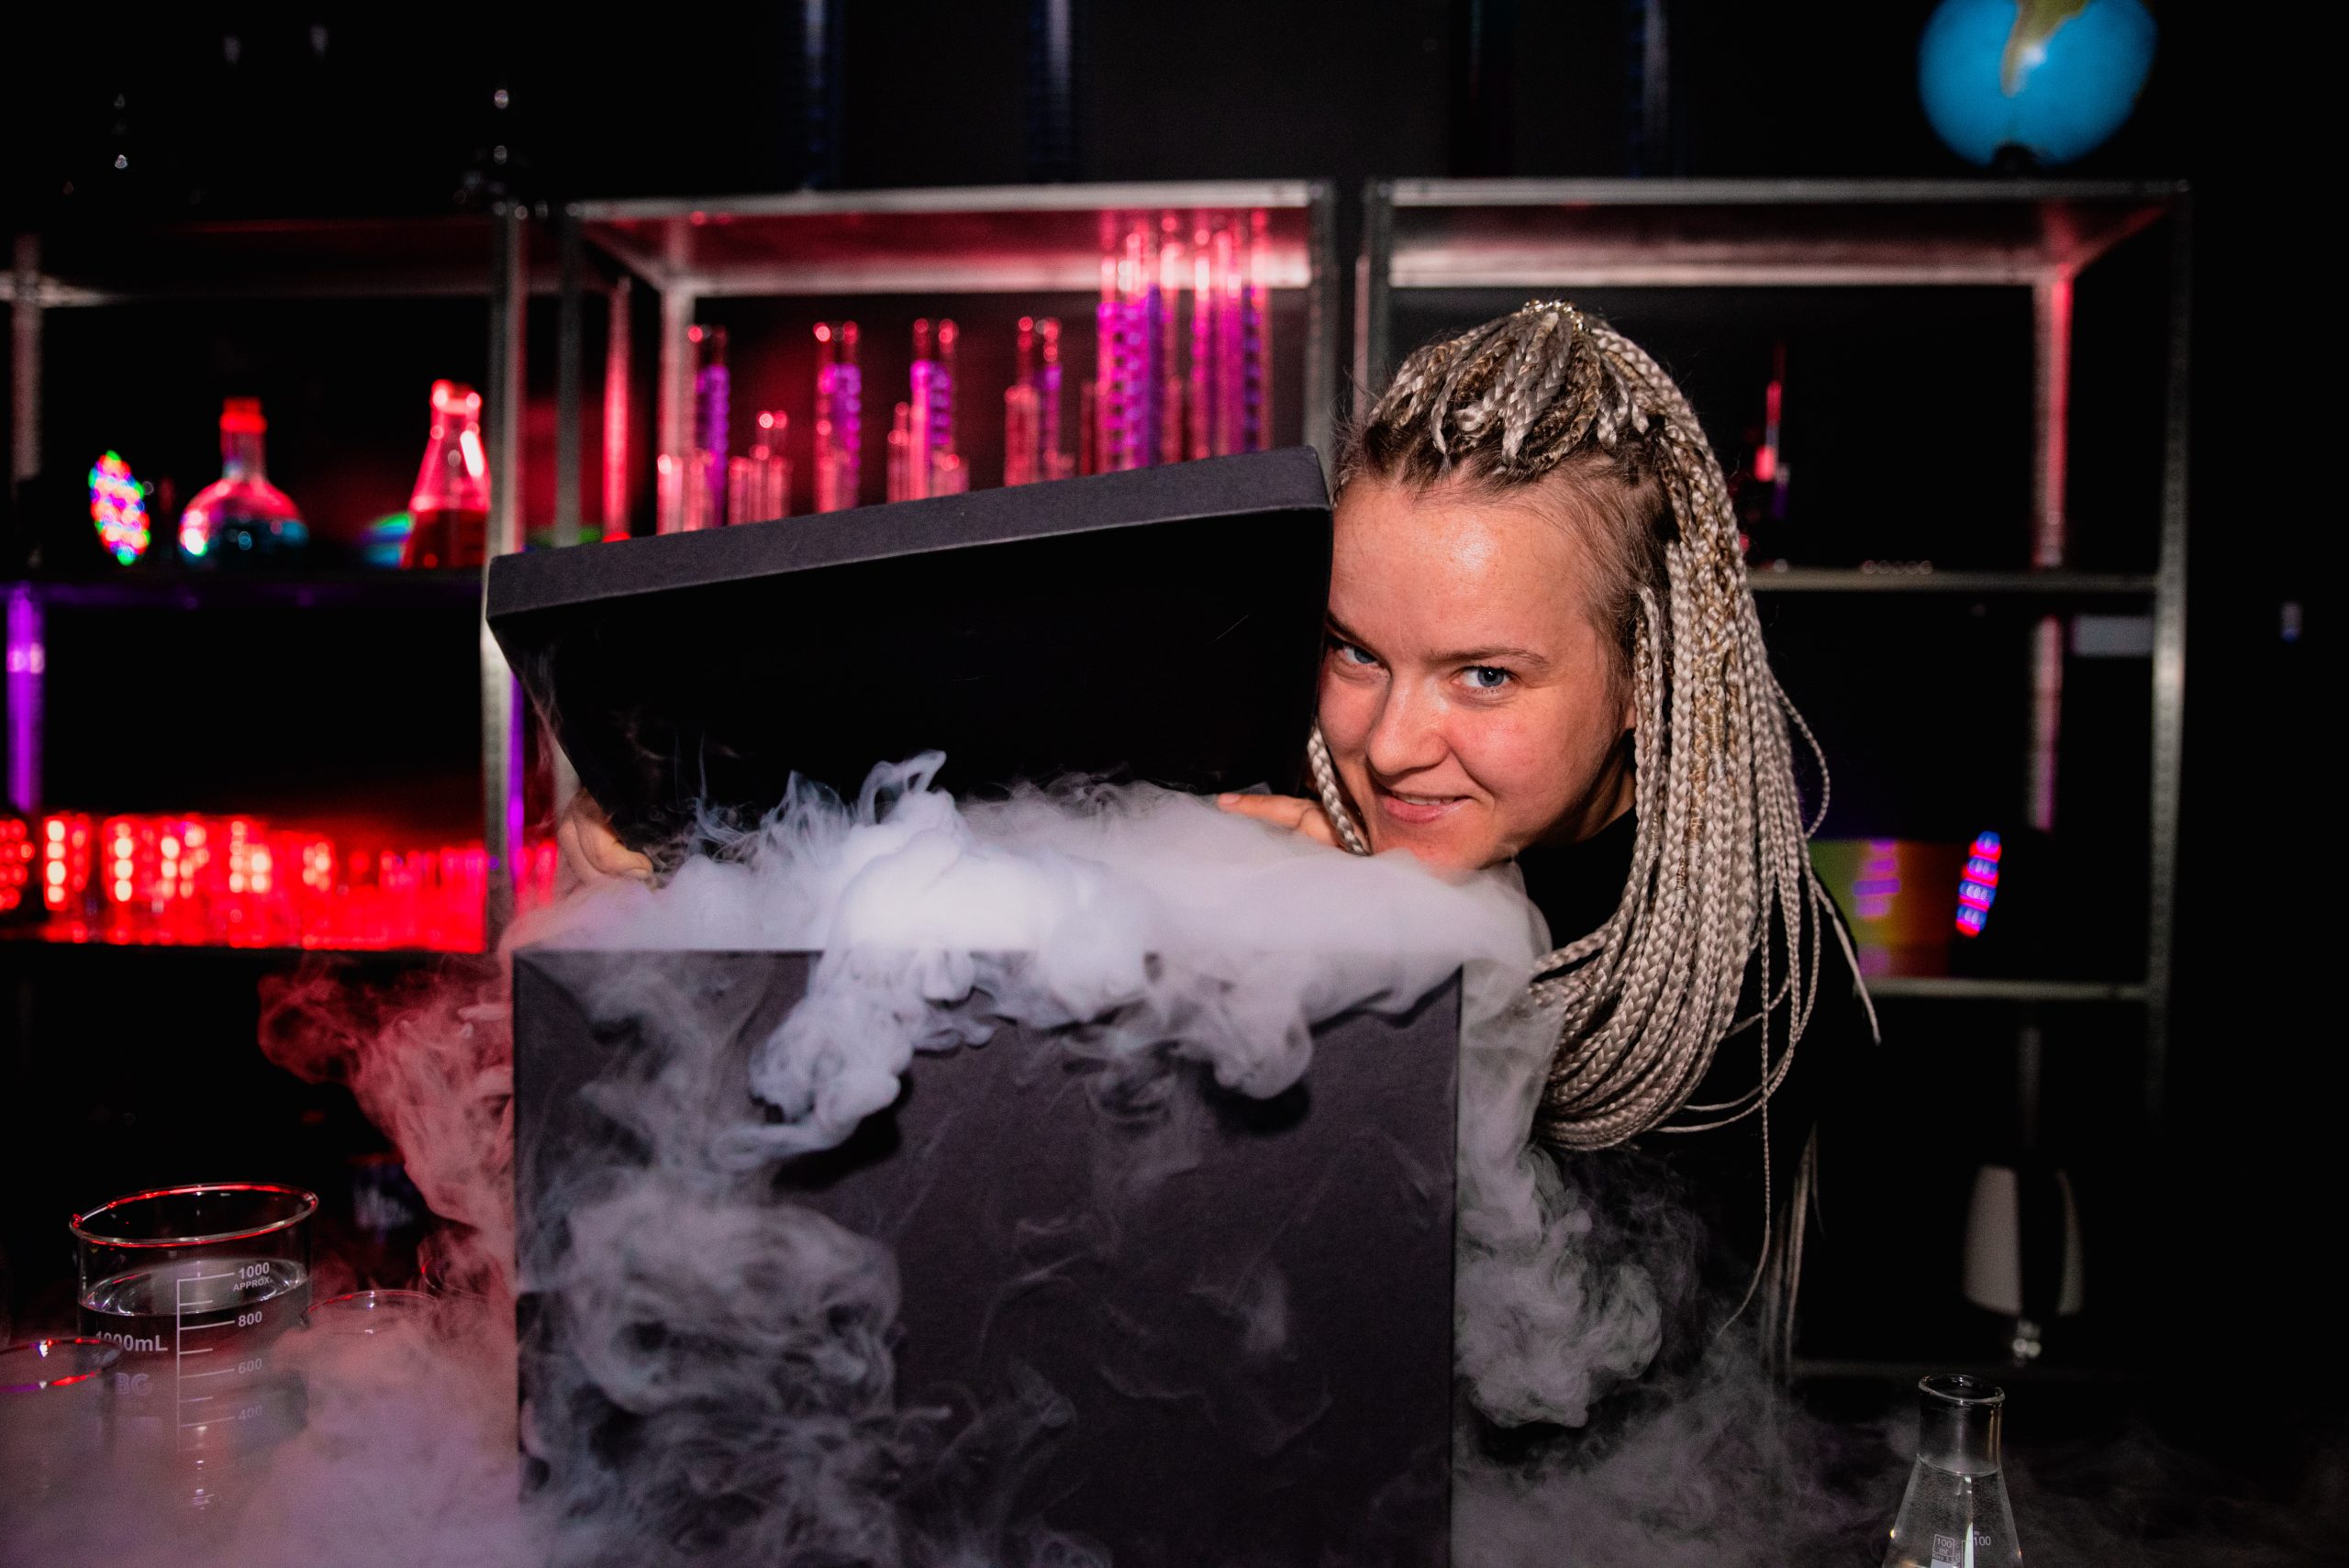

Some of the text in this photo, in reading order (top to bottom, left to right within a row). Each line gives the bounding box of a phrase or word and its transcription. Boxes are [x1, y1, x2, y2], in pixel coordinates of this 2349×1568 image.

[238, 1262, 270, 1280] 1000
[238, 1310, 263, 1328] 800
[238, 1358, 262, 1374] 600
[238, 1406, 262, 1421] 400
[1937, 1538, 1953, 1549] 100
[1973, 1536, 1991, 1546] 100
